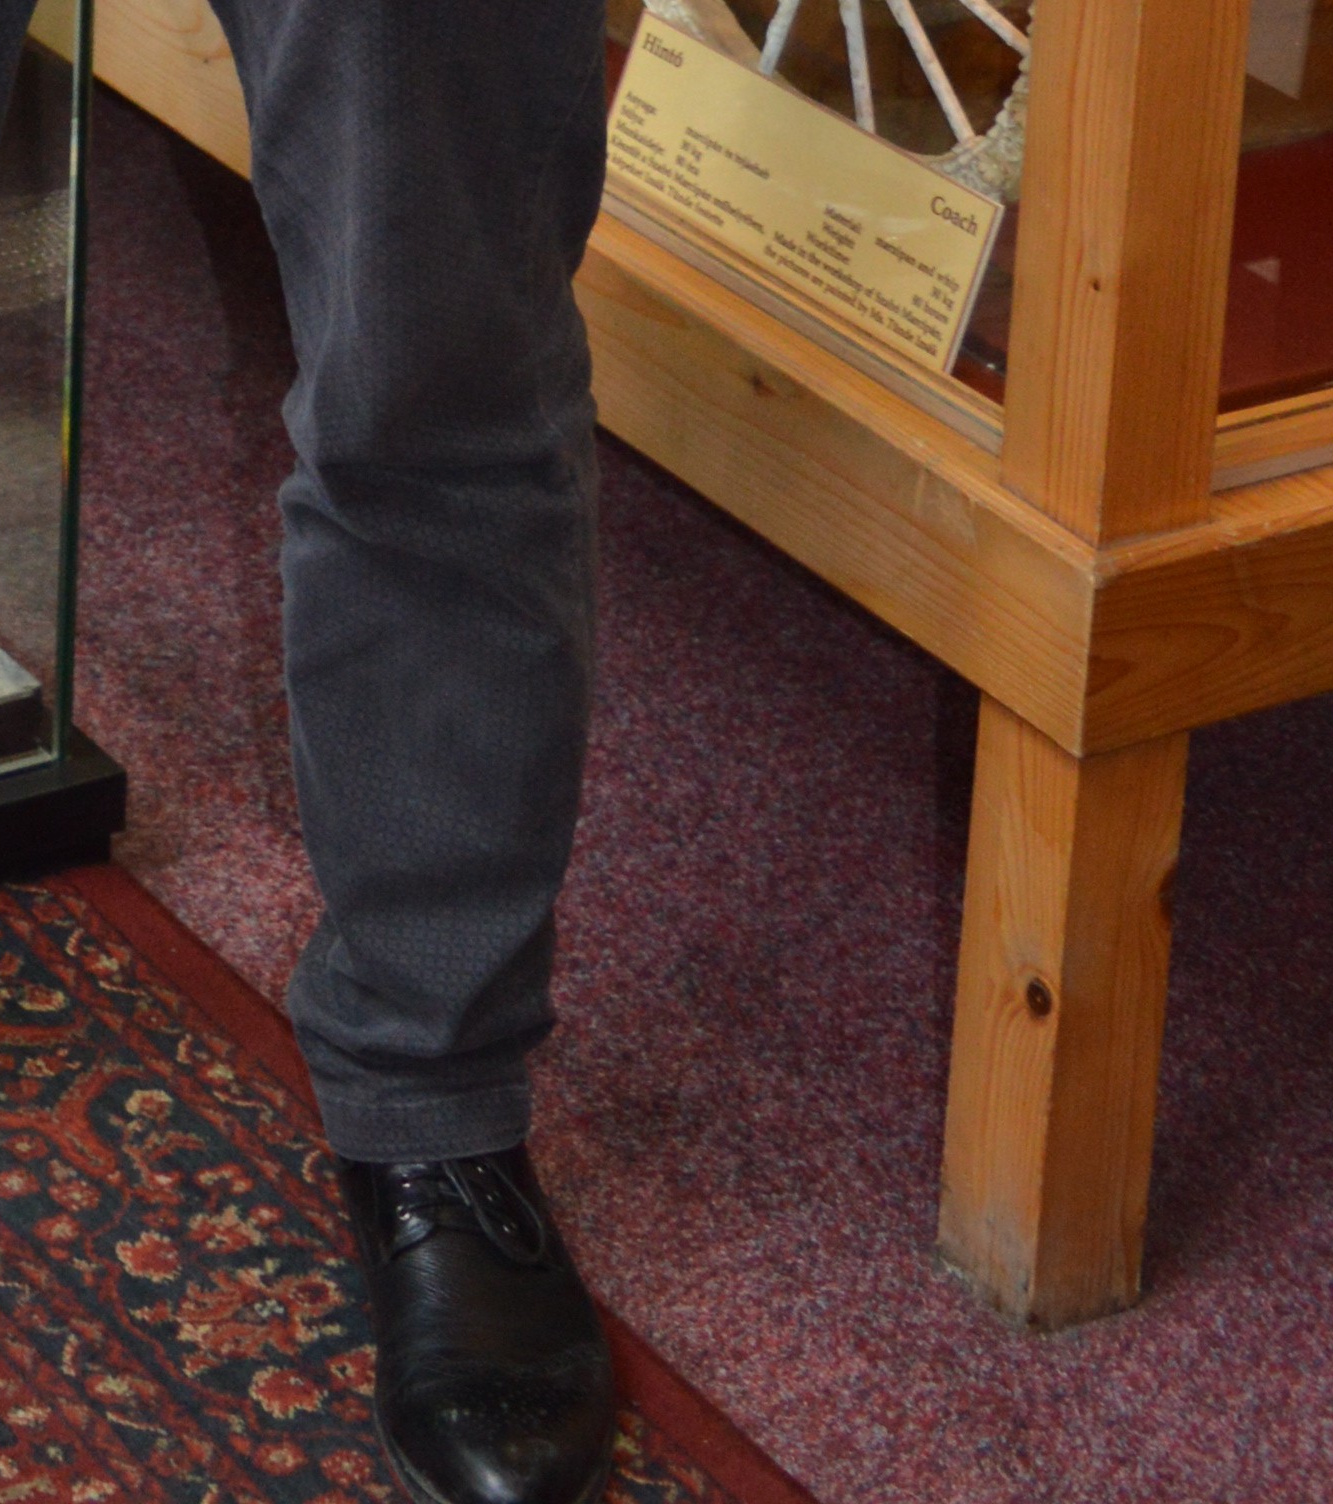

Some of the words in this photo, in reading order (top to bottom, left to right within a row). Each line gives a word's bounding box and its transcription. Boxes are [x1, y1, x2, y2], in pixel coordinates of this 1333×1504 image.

[643, 33, 684, 67] Hintó
[929, 194, 979, 234] Coach
[774, 232, 795, 251] Made
[821, 262, 861, 295] workshop
[918, 260, 934, 276] and
